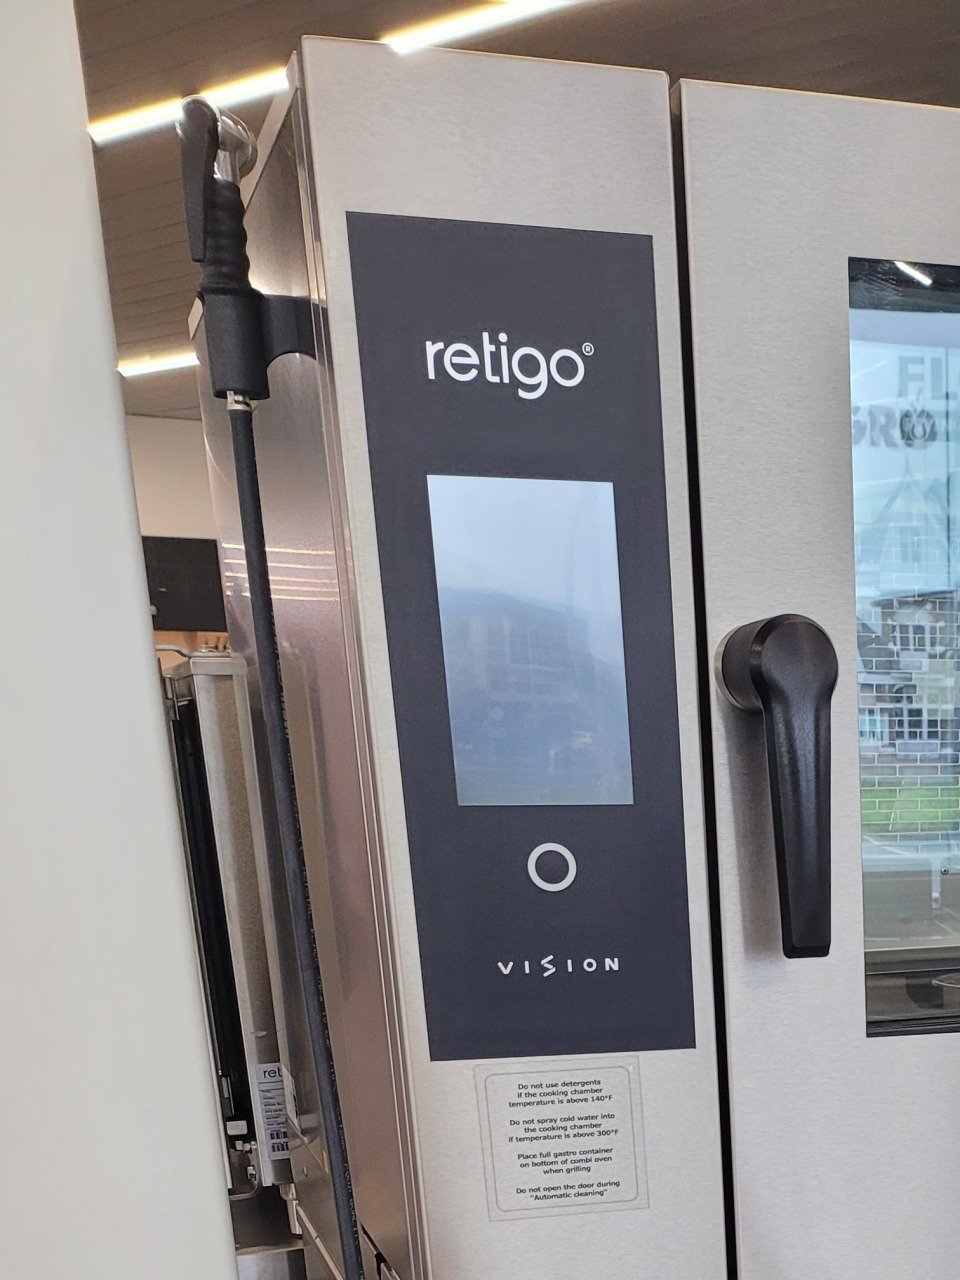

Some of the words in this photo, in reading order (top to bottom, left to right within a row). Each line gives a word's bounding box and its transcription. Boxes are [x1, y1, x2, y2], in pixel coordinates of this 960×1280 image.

[497, 954, 620, 978] VISION
[560, 1079, 601, 1088] detergents
[538, 1089, 569, 1098] cooking
[570, 1087, 603, 1095] chamber
[508, 1099, 556, 1108] temperature
[536, 1117, 558, 1125] spray
[559, 1115, 576, 1123] cold
[523, 1126, 537, 1134] the
[538, 1124, 568, 1133] cooking
[569, 1122, 603, 1131] chamber
[515, 1134, 563, 1143] temperature
[539, 1151, 552, 1159] full
[552, 1150, 578, 1159] gastro
[578, 1147, 614, 1156] container
[569, 1156, 593, 1165] combi
[542, 1167, 564, 1175] when
[565, 1165, 591, 1174] grilling
[542, 1185, 562, 1193] open
[596, 1180, 621, 1188] during
